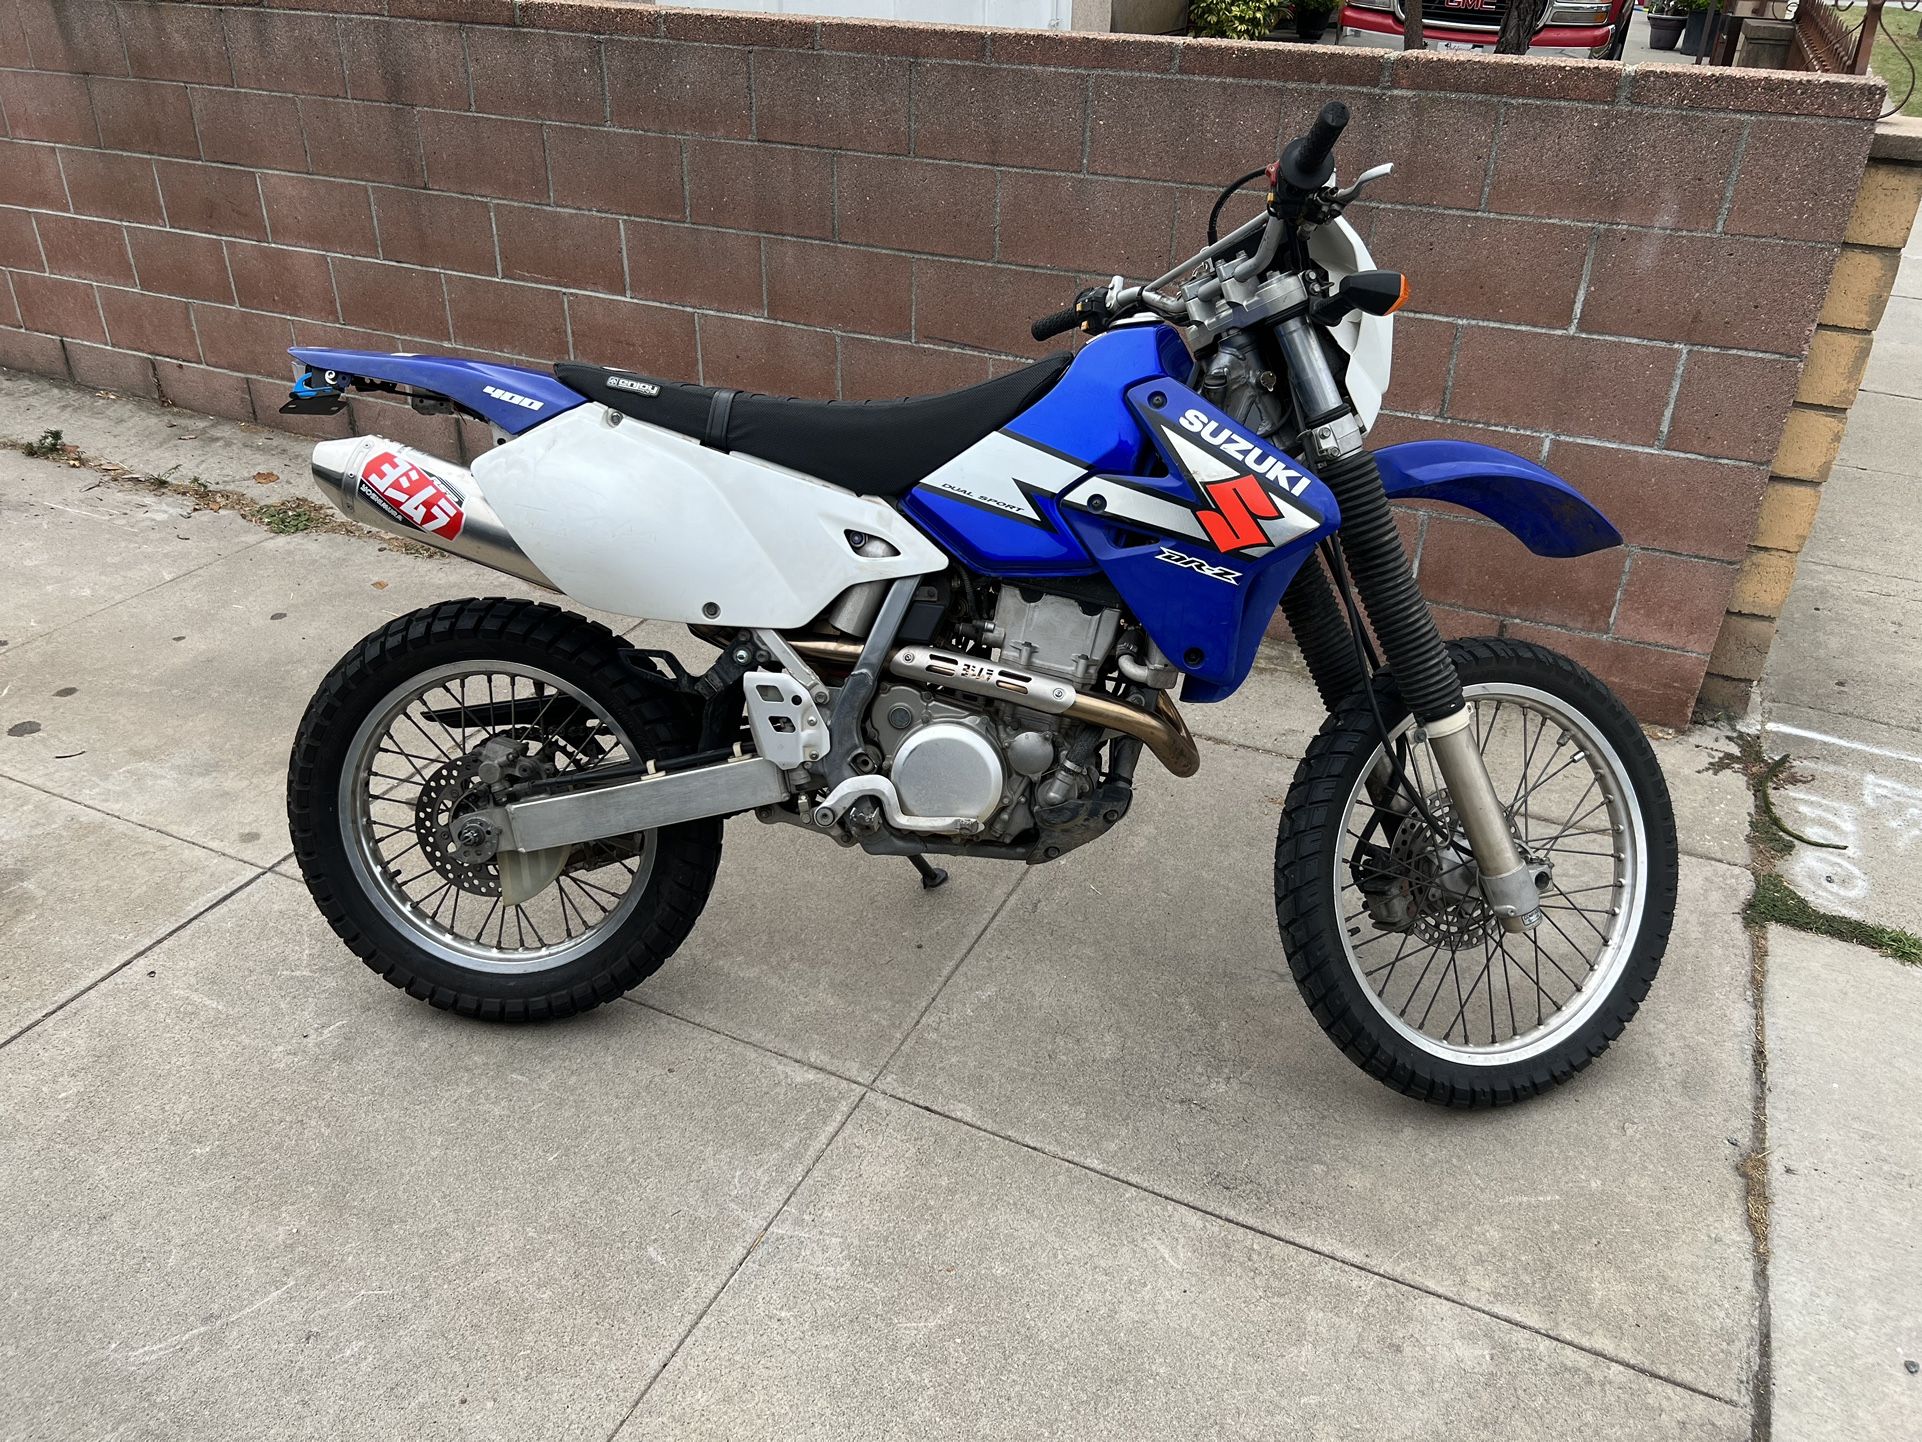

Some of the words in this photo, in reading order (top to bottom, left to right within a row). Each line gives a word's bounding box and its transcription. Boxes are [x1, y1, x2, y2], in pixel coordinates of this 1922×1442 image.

[483, 385, 545, 411] 400
[1178, 409, 1312, 498] SUZUKI
[360, 483, 403, 522] YOSHIMURA
[942, 483, 973, 497] DUAL
[978, 495, 1025, 512] SPORT
